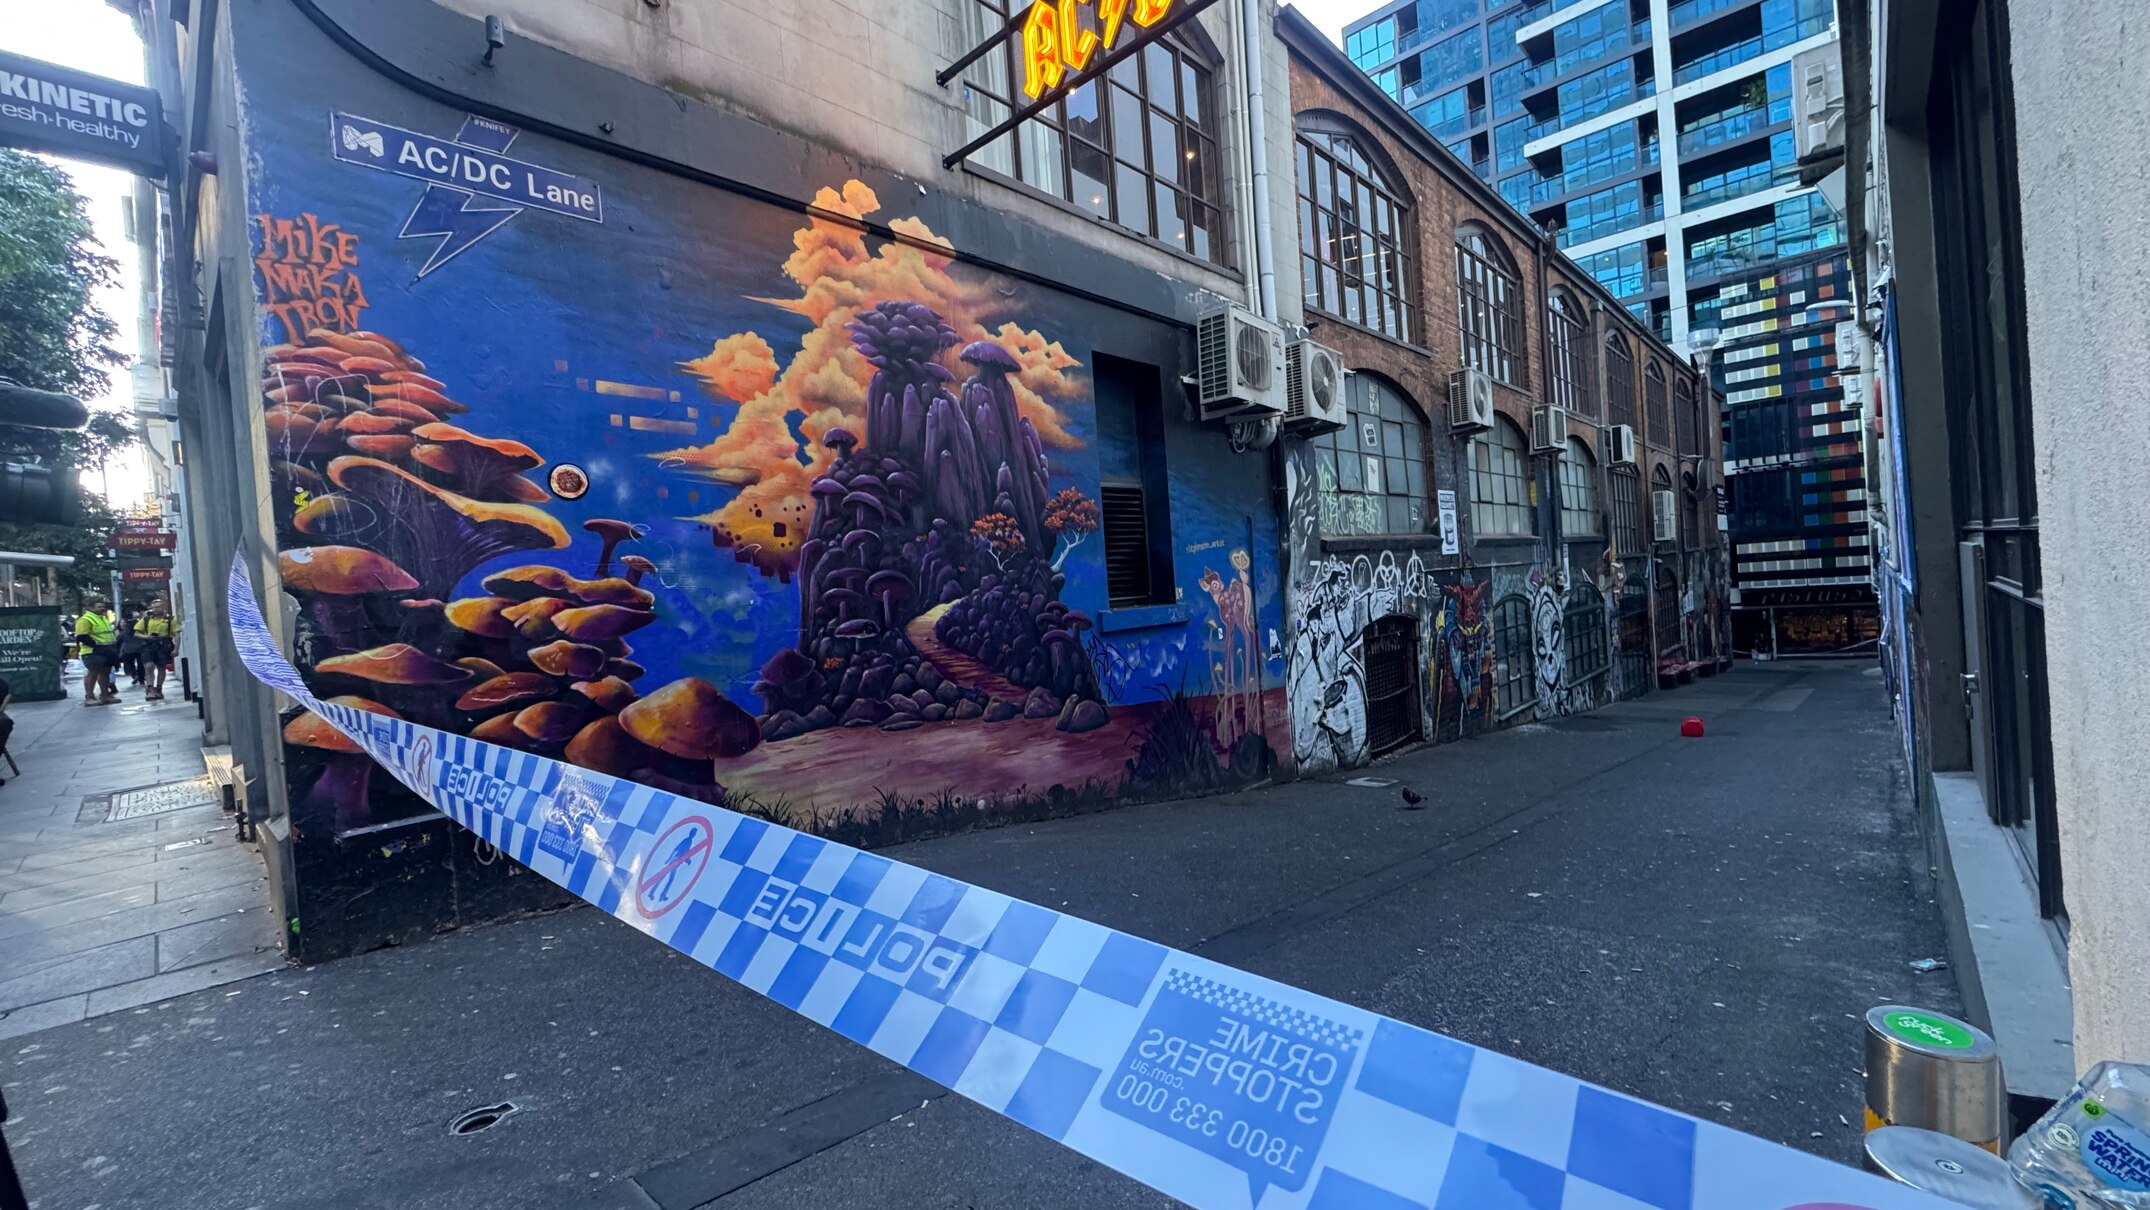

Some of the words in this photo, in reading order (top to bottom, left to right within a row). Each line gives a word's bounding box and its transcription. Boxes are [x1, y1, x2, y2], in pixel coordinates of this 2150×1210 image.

[0, 70, 148, 127] KINETIC
[473, 118, 511, 135] #KNIFEY
[398, 140, 512, 191] AC/DC
[527, 172, 596, 212] Lane
[118, 537, 167, 545] TIPPY-TAY
